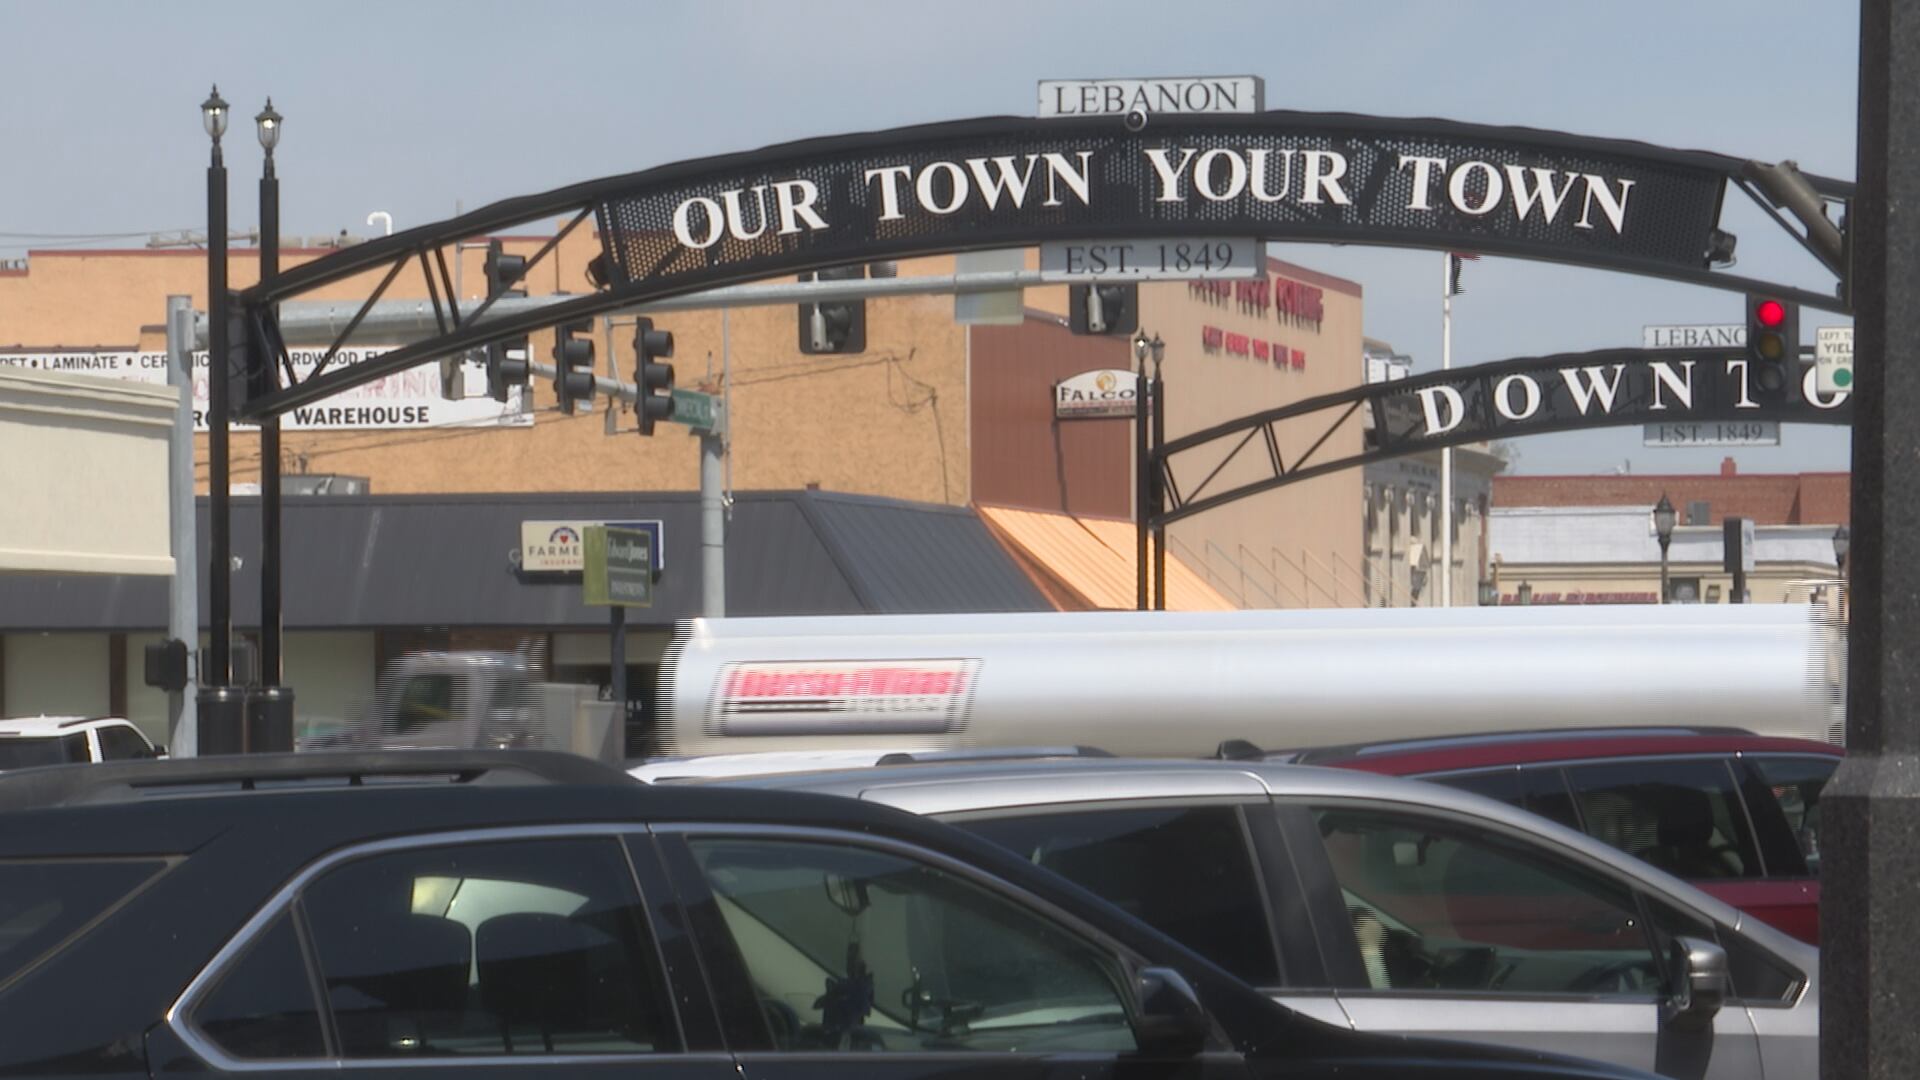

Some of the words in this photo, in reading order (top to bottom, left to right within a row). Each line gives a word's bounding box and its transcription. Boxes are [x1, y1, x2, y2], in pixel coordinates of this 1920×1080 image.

[1056, 82, 1239, 114] LEBANON
[673, 179, 830, 249] OUR
[865, 151, 1094, 221] TOWN
[1144, 148, 1353, 206] YOUR
[1399, 155, 1637, 235] TOWN
[1065, 244, 1140, 275] EST.
[1158, 242, 1234, 273] 1849
[1654, 327, 1747, 347] LEBANO
[1824, 343, 1853, 353] YIEL
[43, 355, 118, 369] LAMINATE
[1060, 387, 1136, 400] FALCO
[294, 406, 429, 425] WAREHOUSE
[1717, 423, 1763, 441] 1849
[528, 545, 580, 557] FARME
